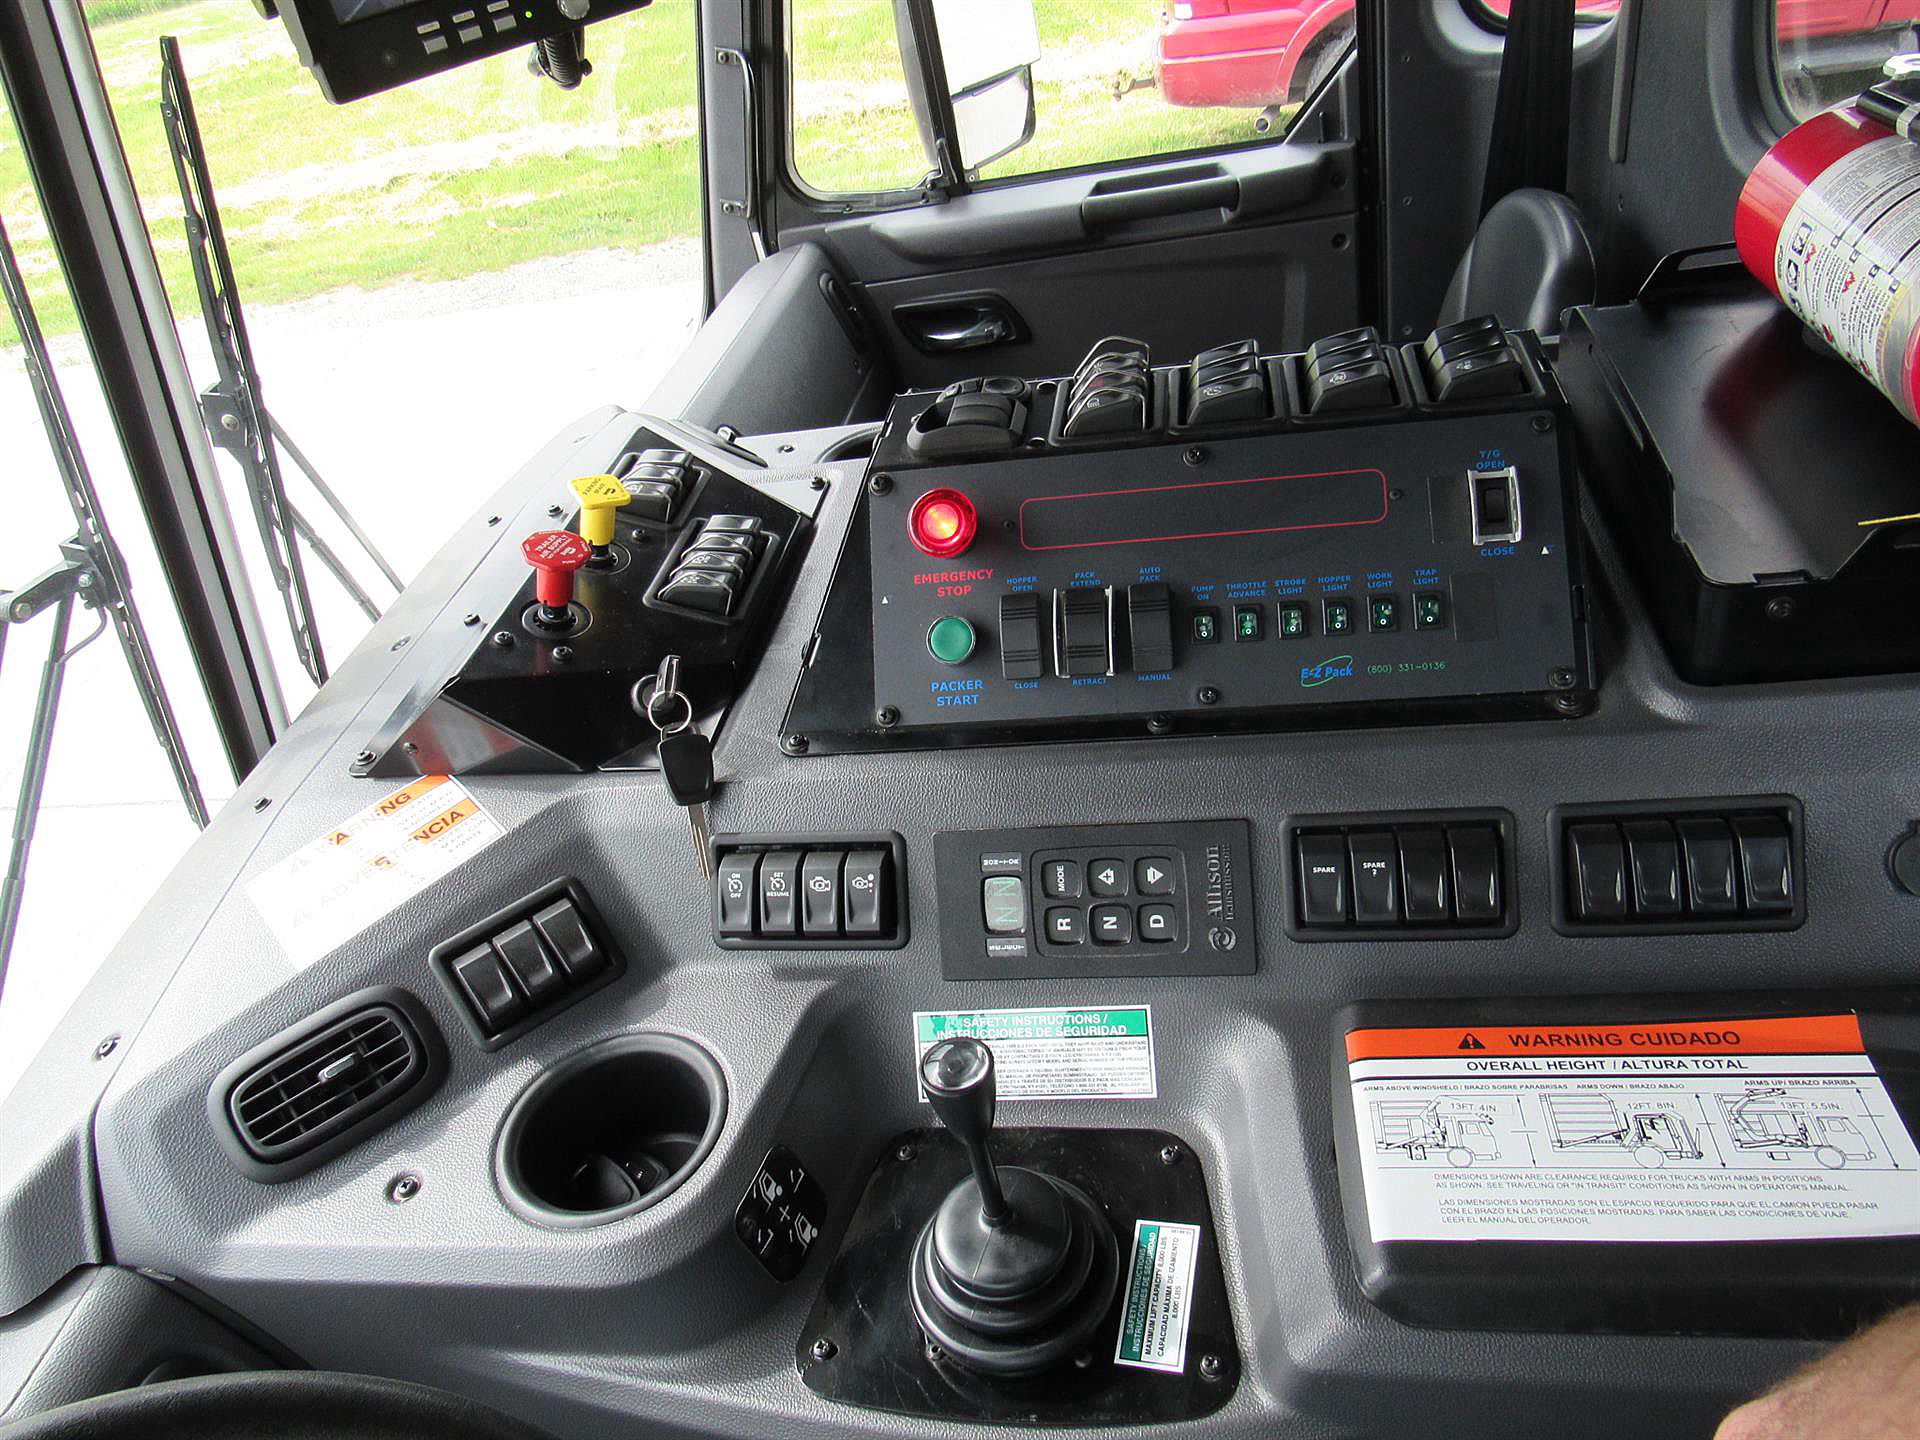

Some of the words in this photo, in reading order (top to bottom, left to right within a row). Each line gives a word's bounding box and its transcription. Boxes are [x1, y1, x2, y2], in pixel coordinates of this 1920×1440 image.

[1480, 449, 1500, 459] T/G
[1476, 460, 1505, 469] OPEN
[1481, 546, 1515, 556] CLOSE
[913, 568, 993, 585] EMERGENCY
[1007, 576, 1038, 584] HOPPER
[1367, 572, 1392, 580] WORK
[1413, 577, 1439, 585] LIGHT
[1226, 581, 1266, 590] THROTTLE
[1275, 579, 1306, 587] STROBE
[1323, 584, 1348, 592] LIGHT
[1368, 581, 1392, 589] LIGHT
[937, 585, 972, 597] STOP
[1228, 590, 1265, 598] ADVANCE
[1301, 666, 1323, 679] E-Z
[1325, 665, 1353, 678] Pack
[1367, 664, 1392, 674] (800)
[1398, 661, 1446, 673] 331-0136
[1072, 678, 1106, 686] RETRACT
[1137, 673, 1172, 681] MANUAL
[931, 680, 983, 692] PACKER
[937, 694, 979, 706] START
[1057, 865, 1065, 892] MODE
[1206, 844, 1223, 920] Allison
[1057, 918, 1072, 931] R
[1103, 916, 1117, 929] N
[1150, 914, 1164, 928] D
[963, 1016, 1009, 1028] SAFETY
[1011, 1014, 1101, 1026] INSTRUCTIONS
[937, 1026, 1033, 1040] INSTRUCCIONES
[1036, 1026, 1054, 1037] DE
[1055, 1025, 1127, 1036] SEGURIDAD
[1508, 1032, 1623, 1048] WARNING
[1630, 1030, 1741, 1047] CUIDADO
[1466, 1061, 1542, 1072] OVERALL
[1546, 1060, 1605, 1071] HEIGHT
[1621, 1059, 1689, 1070] ALTURA
[1691, 1059, 1749, 1070] TOTAL
[1629, 1182, 1685, 1190] CONDITIONS
[1685, 1209, 1718, 1217] SABER
[1738, 1210, 1805, 1218] CONDICIONES
[1168, 1237, 1180, 1273] IZAMIENTO
[1167, 1274, 1175, 1284] DE
[1145, 1320, 1156, 1356] MAXIMUM
[1152, 1268, 1162, 1303] CAPACITY
[1126, 1303, 1137, 1335] SAFETY
[1157, 1313, 1169, 1357] CAPACIDAD
